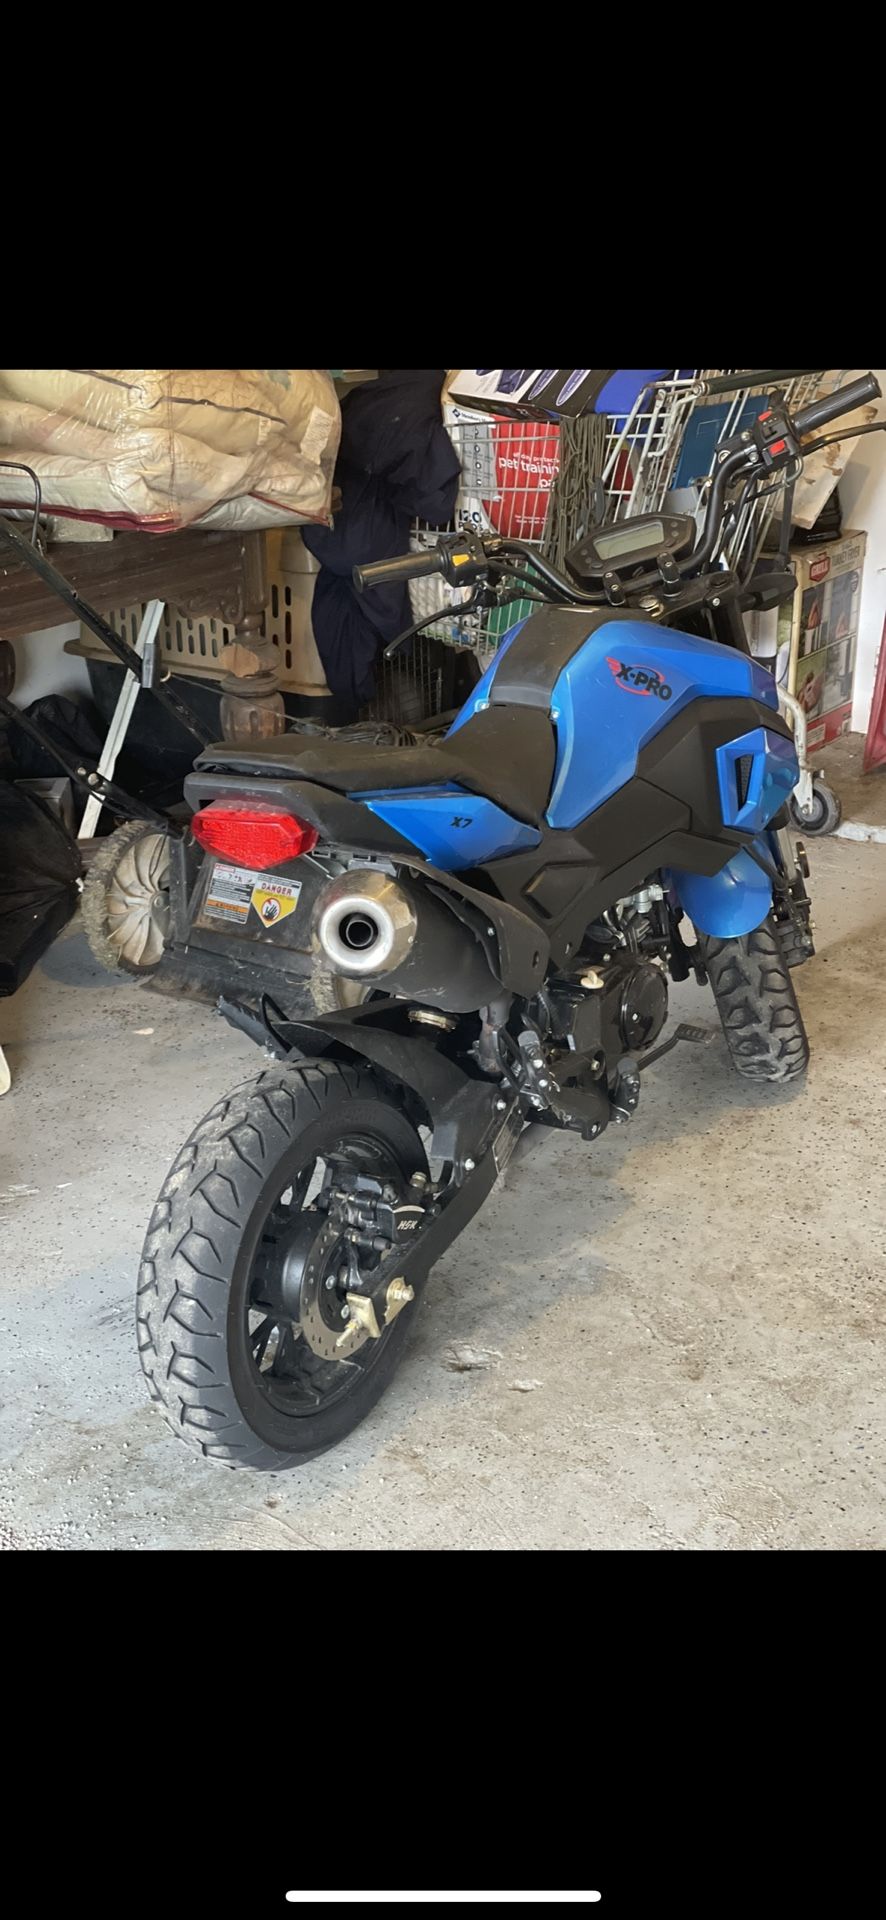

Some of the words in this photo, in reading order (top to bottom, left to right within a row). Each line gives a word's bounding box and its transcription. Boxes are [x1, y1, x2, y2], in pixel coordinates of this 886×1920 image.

[498, 457, 519, 470] pet
[521, 459, 560, 475] trainin
[616, 662, 672, 701] X-PRO
[450, 816, 473, 829] X7
[261, 883, 293, 896] DANGER
